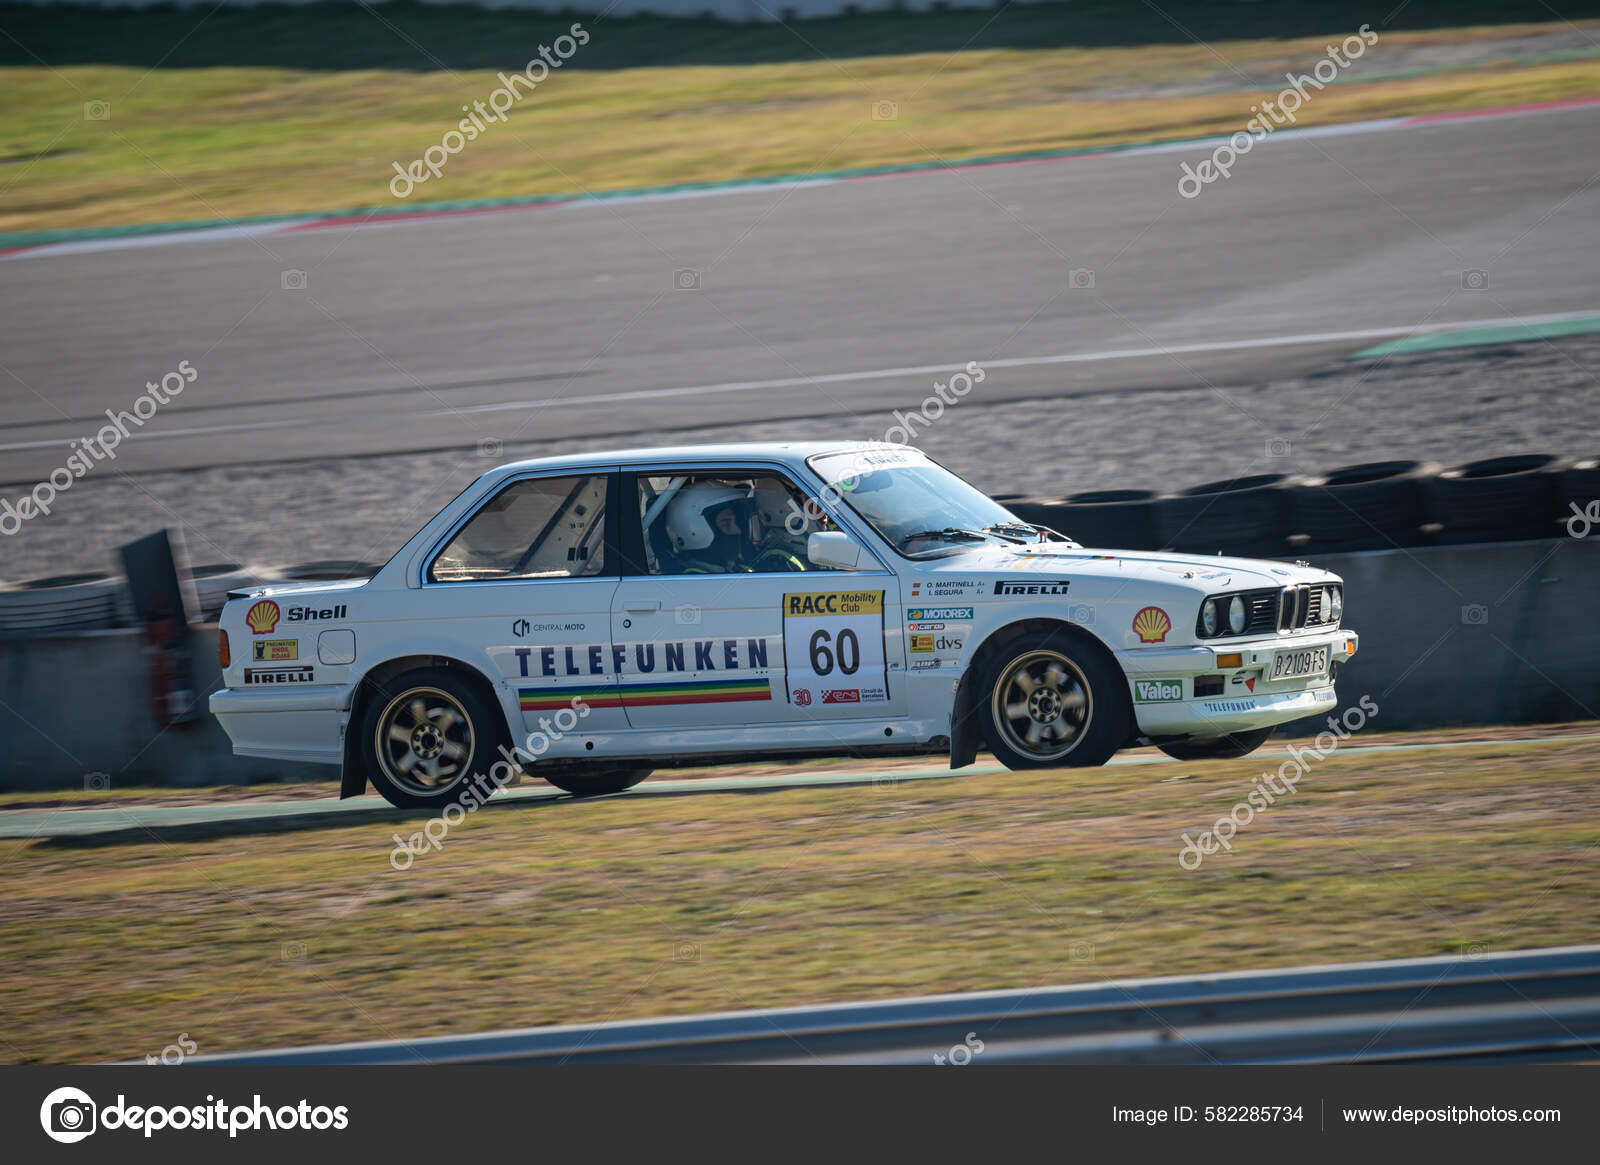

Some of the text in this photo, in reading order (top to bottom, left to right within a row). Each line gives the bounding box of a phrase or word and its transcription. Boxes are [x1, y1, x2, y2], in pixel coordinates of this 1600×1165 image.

[993, 580, 1070, 595] PIRELLI
[790, 593, 877, 614] RACC Mobility
[841, 604, 860, 612] Club
[287, 604, 347, 621] Shell
[923, 608, 972, 618] MOTOREX
[936, 636, 963, 649] dvs
[514, 638, 769, 677] TELEFUNKEN
[809, 628, 860, 676] 60
[244, 666, 314, 684] PIRELLI
[1137, 681, 1182, 700] Valeo
